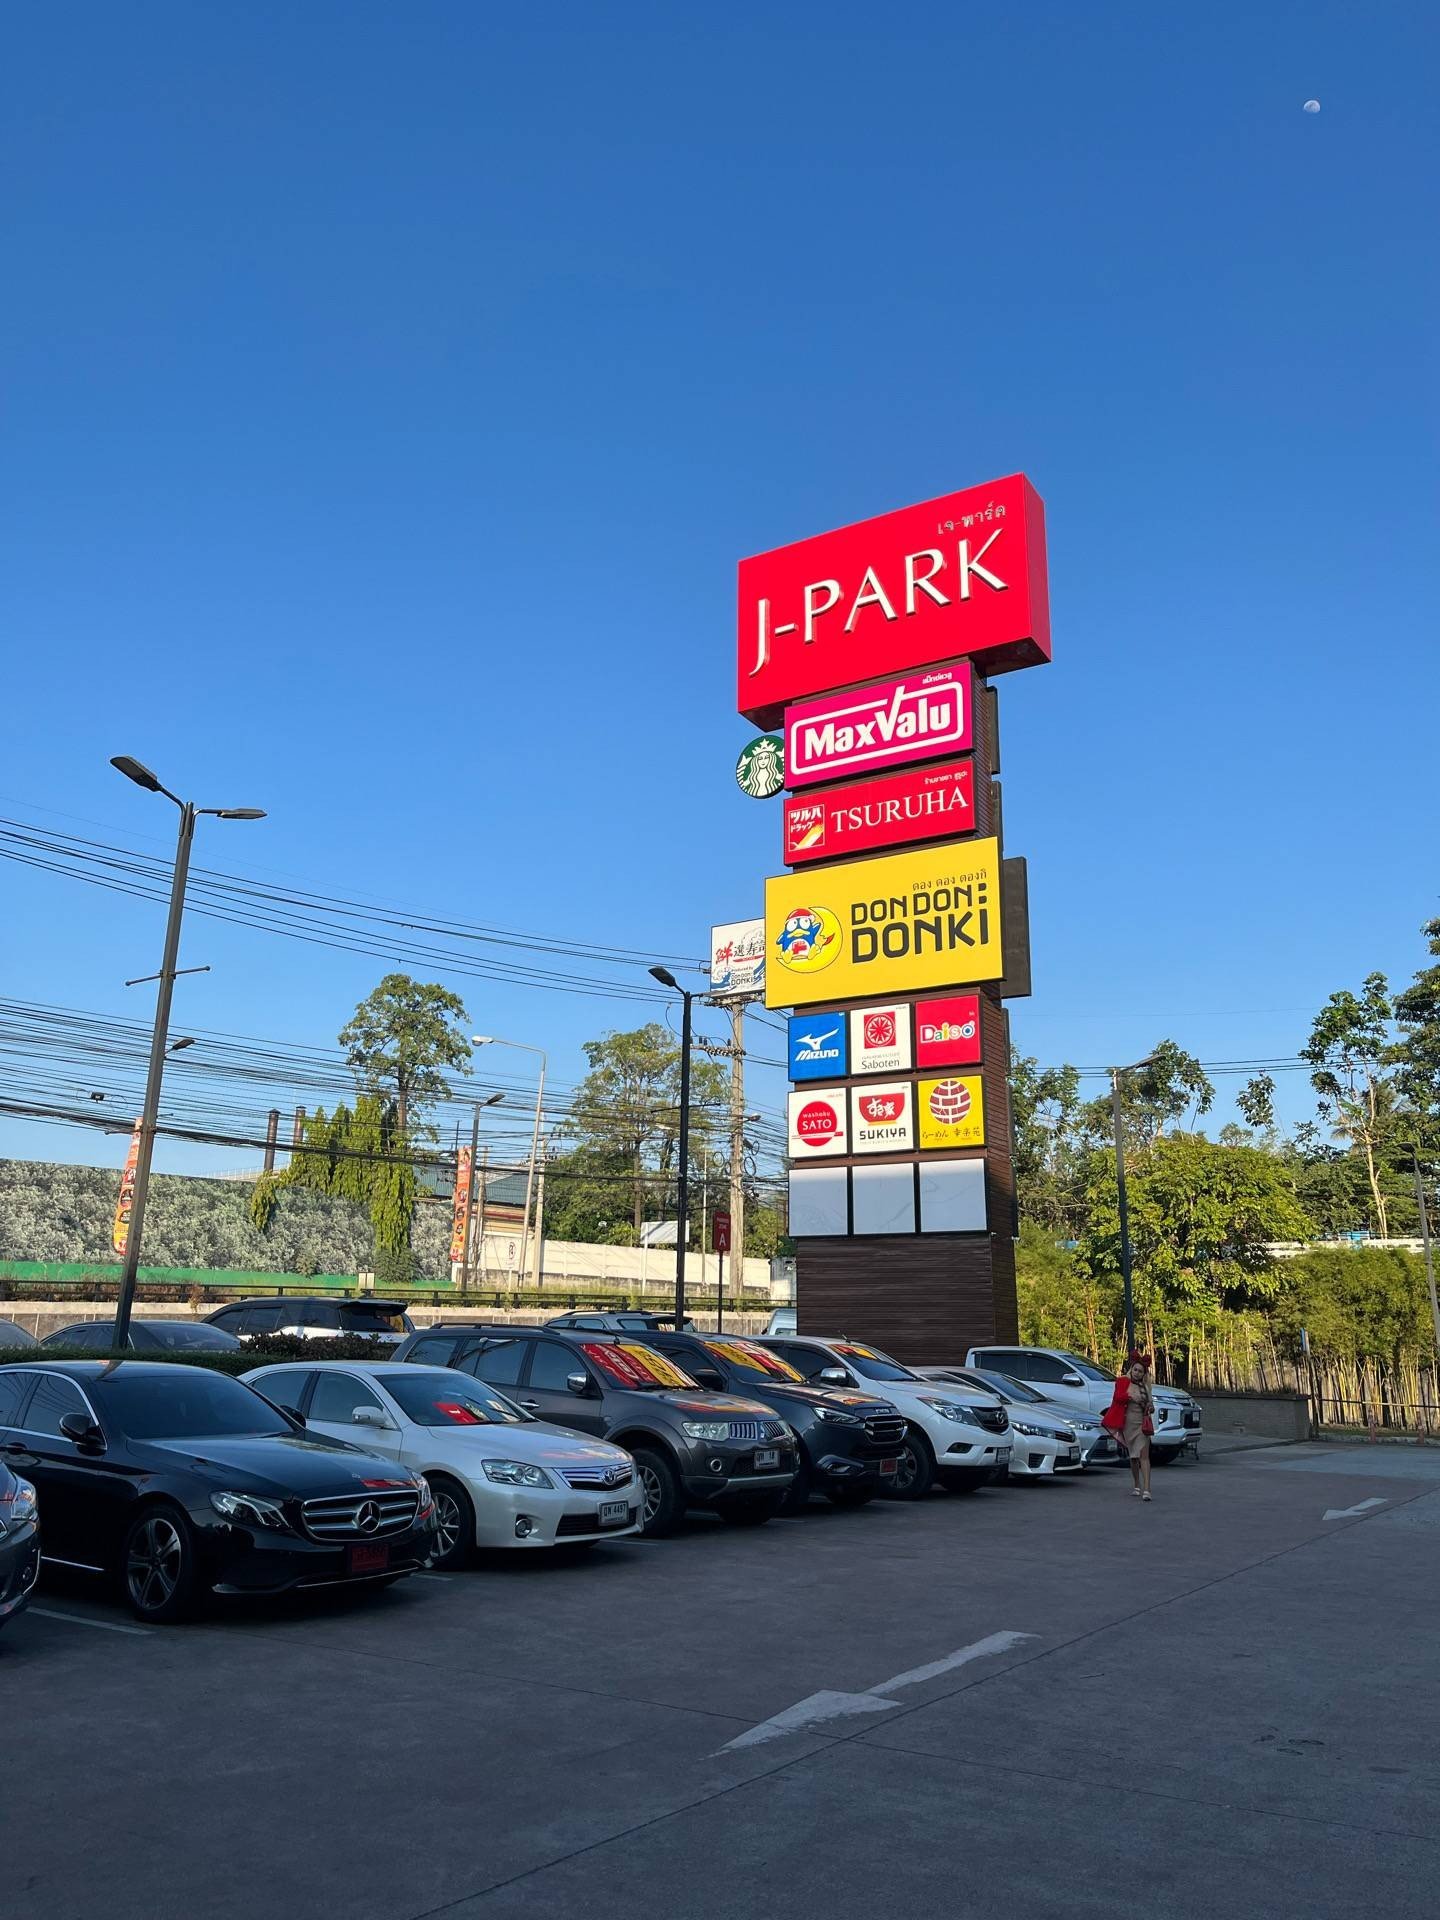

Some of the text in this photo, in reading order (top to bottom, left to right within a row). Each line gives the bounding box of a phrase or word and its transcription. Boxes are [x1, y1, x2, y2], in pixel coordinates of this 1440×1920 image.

[749, 528, 1009, 676] J-PARK
[803, 686, 951, 760] MaxValu
[790, 806, 822, 823] ツルハ
[831, 786, 969, 833] TSURUHA
[851, 895, 908, 926] DON
[851, 908, 989, 964] DONKI
[920, 1020, 976, 1044] Daiso
[861, 1059, 900, 1070] Saboten
[802, 1119, 832, 1131] SATO
[859, 1127, 907, 1140] SUKIYA
[719, 1233, 726, 1246] A
